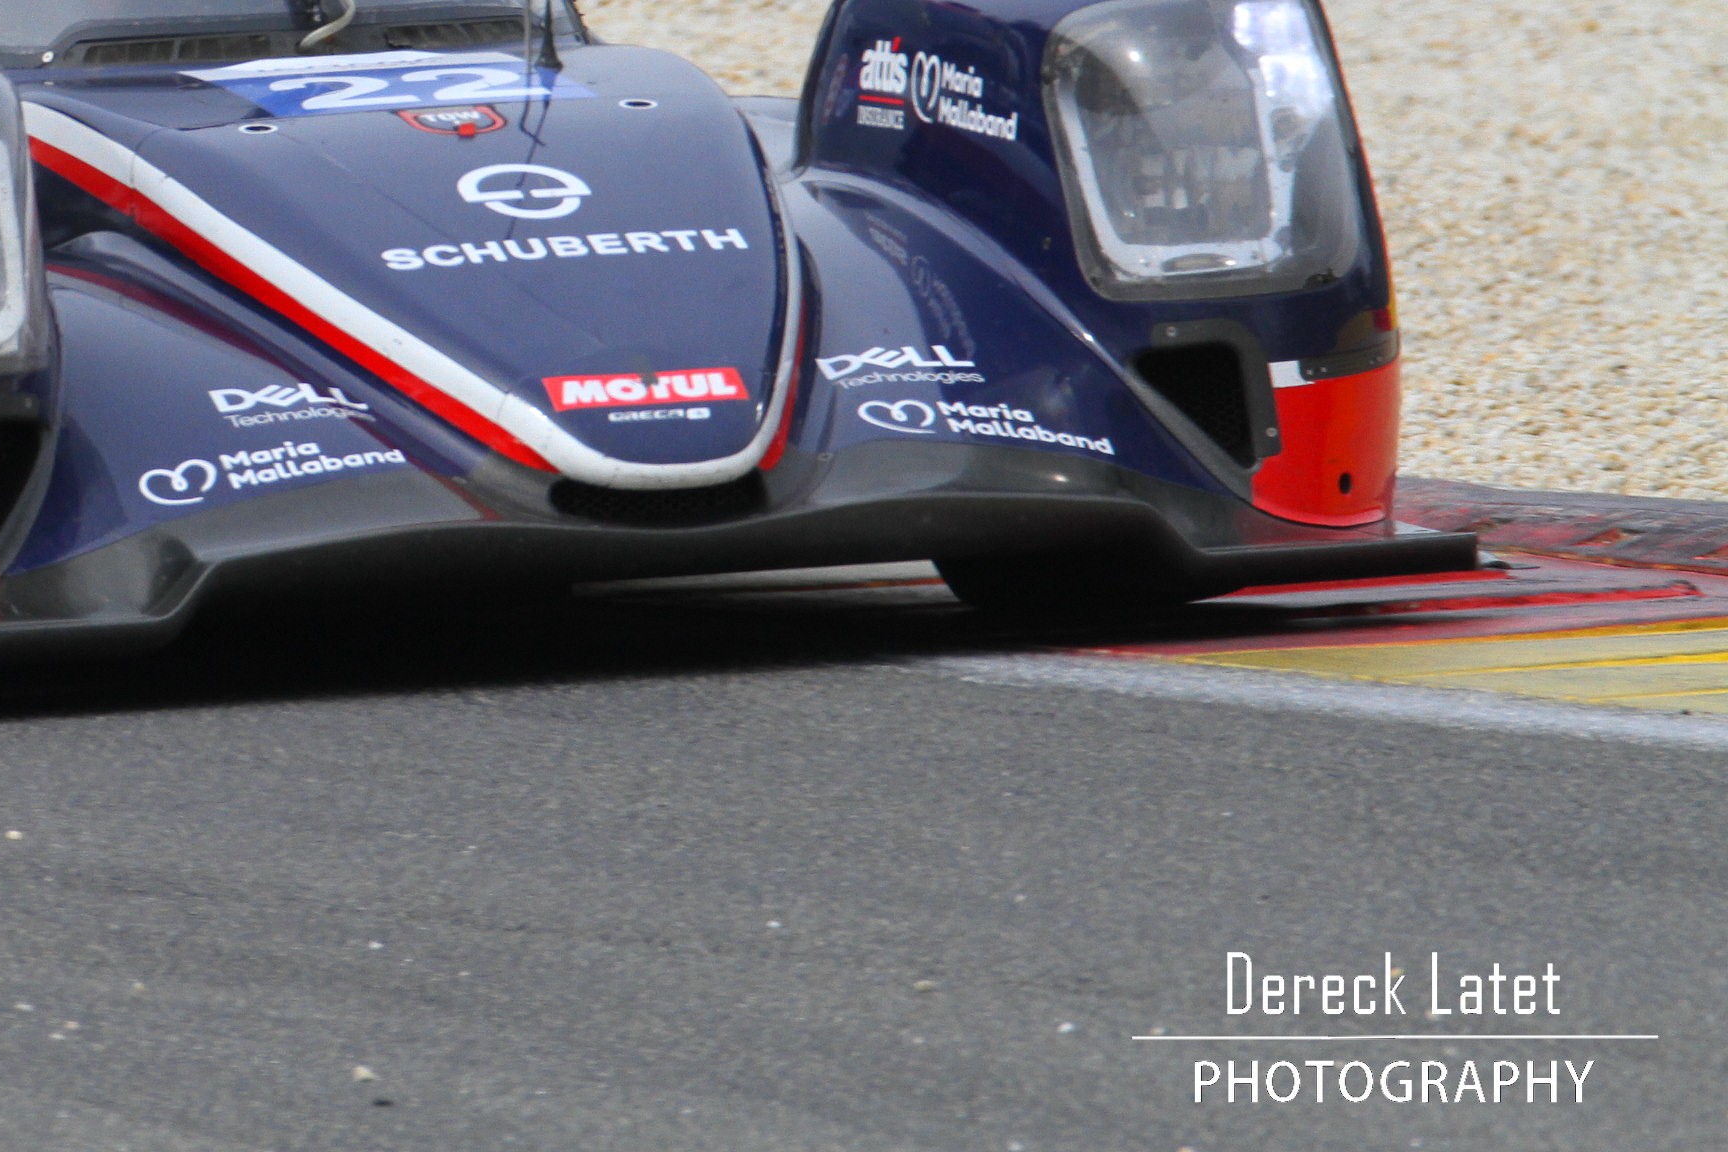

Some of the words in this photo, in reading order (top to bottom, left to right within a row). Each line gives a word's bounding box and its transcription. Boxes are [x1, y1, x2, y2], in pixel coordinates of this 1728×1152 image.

[859, 36, 909, 95] attis
[941, 61, 984, 98] Maria
[269, 67, 553, 111] 22
[937, 95, 1019, 142] Mallaband
[381, 227, 749, 271] SCHUBERTH
[815, 344, 976, 381] DELL
[835, 369, 986, 390] Technologies
[208, 382, 370, 413] DELL
[936, 401, 1035, 424] Maria
[219, 440, 320, 471] Maria
[947, 418, 1115, 456] Mallaband
[228, 448, 407, 490] Mallaband
